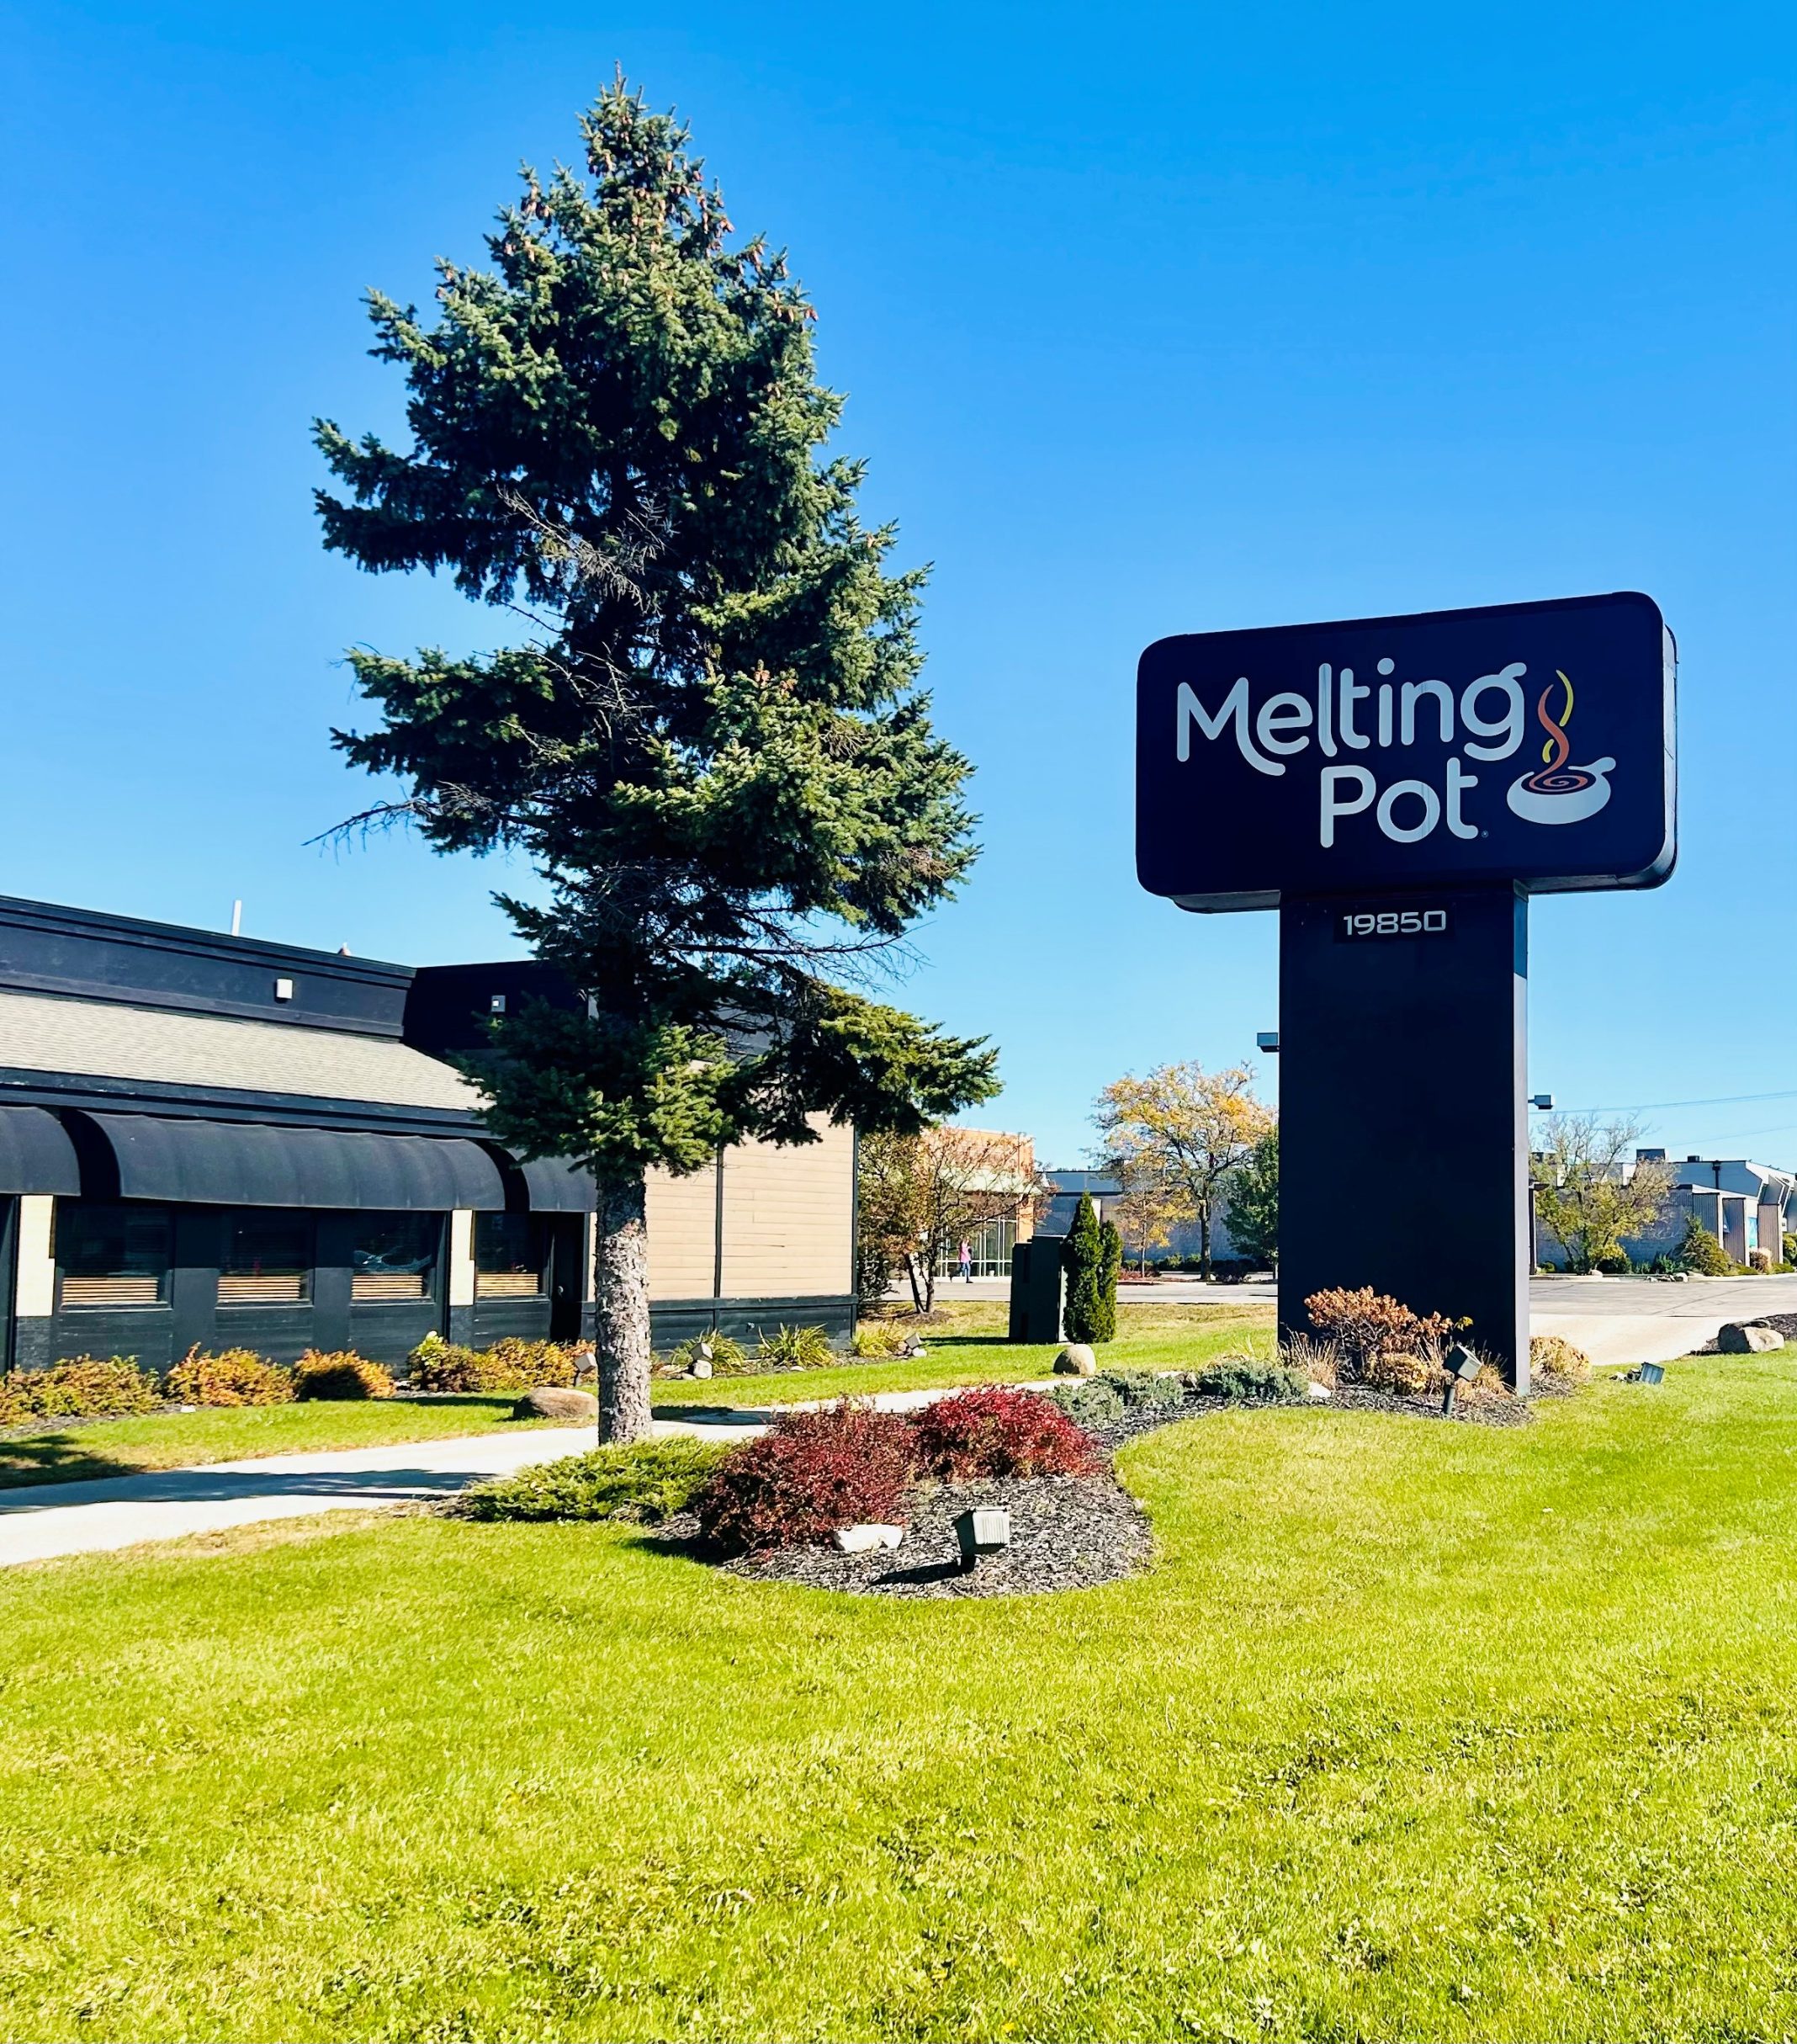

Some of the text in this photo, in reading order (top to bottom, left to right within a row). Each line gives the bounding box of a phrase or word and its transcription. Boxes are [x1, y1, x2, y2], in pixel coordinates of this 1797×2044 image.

[1176, 657, 1527, 777] Melting
[1320, 757, 1479, 848] Pot
[1342, 910, 1447, 936] 19850
